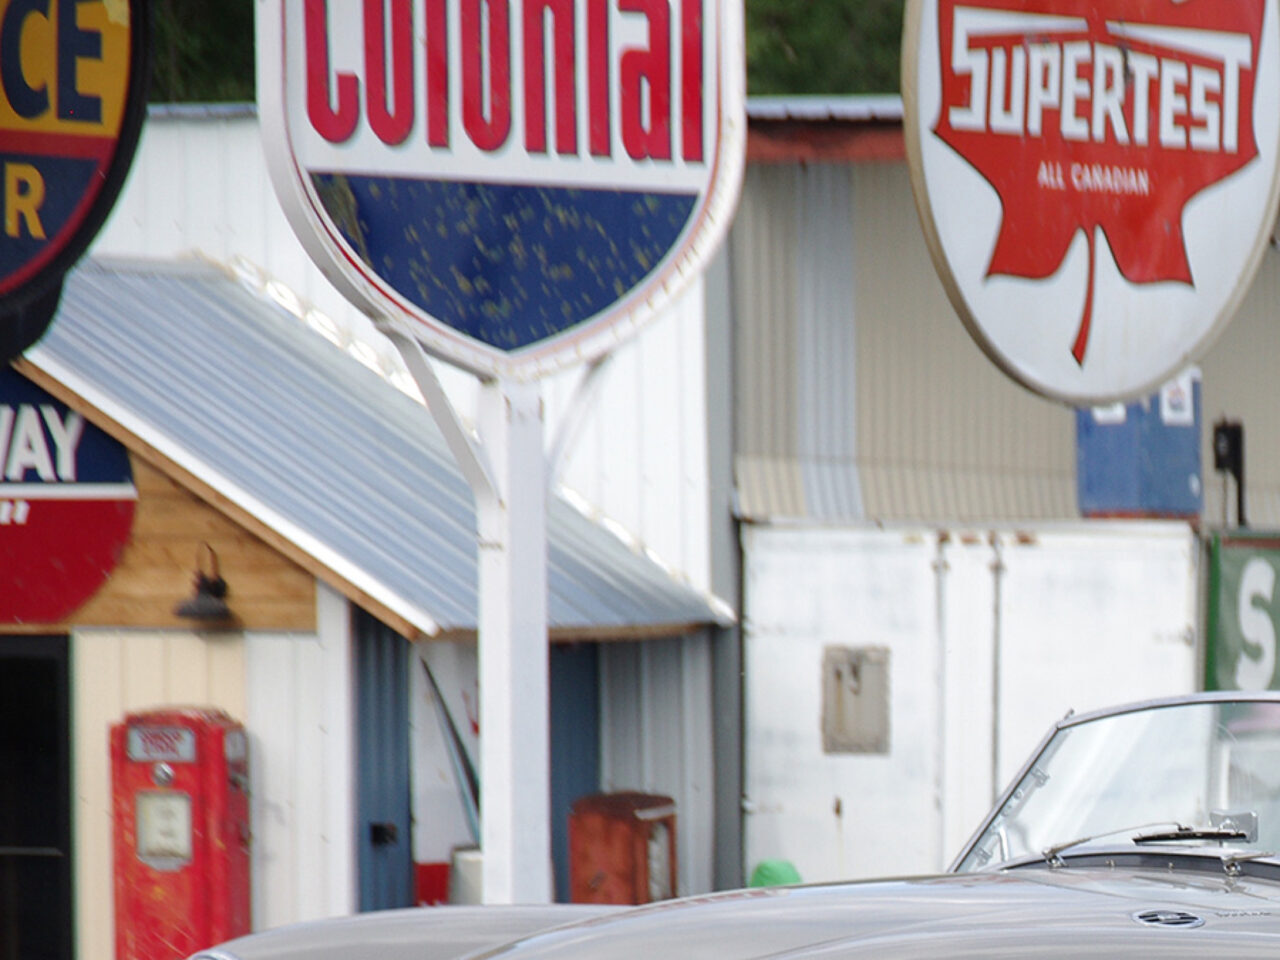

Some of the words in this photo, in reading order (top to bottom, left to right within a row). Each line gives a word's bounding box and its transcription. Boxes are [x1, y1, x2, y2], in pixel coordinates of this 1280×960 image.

[948, 6, 1253, 154] SUPERTEST
[4, 161, 49, 240] R
[1037, 160, 1066, 191] ALL
[1070, 163, 1150, 197] CANADIAN
[0, 403, 84, 482] AY
